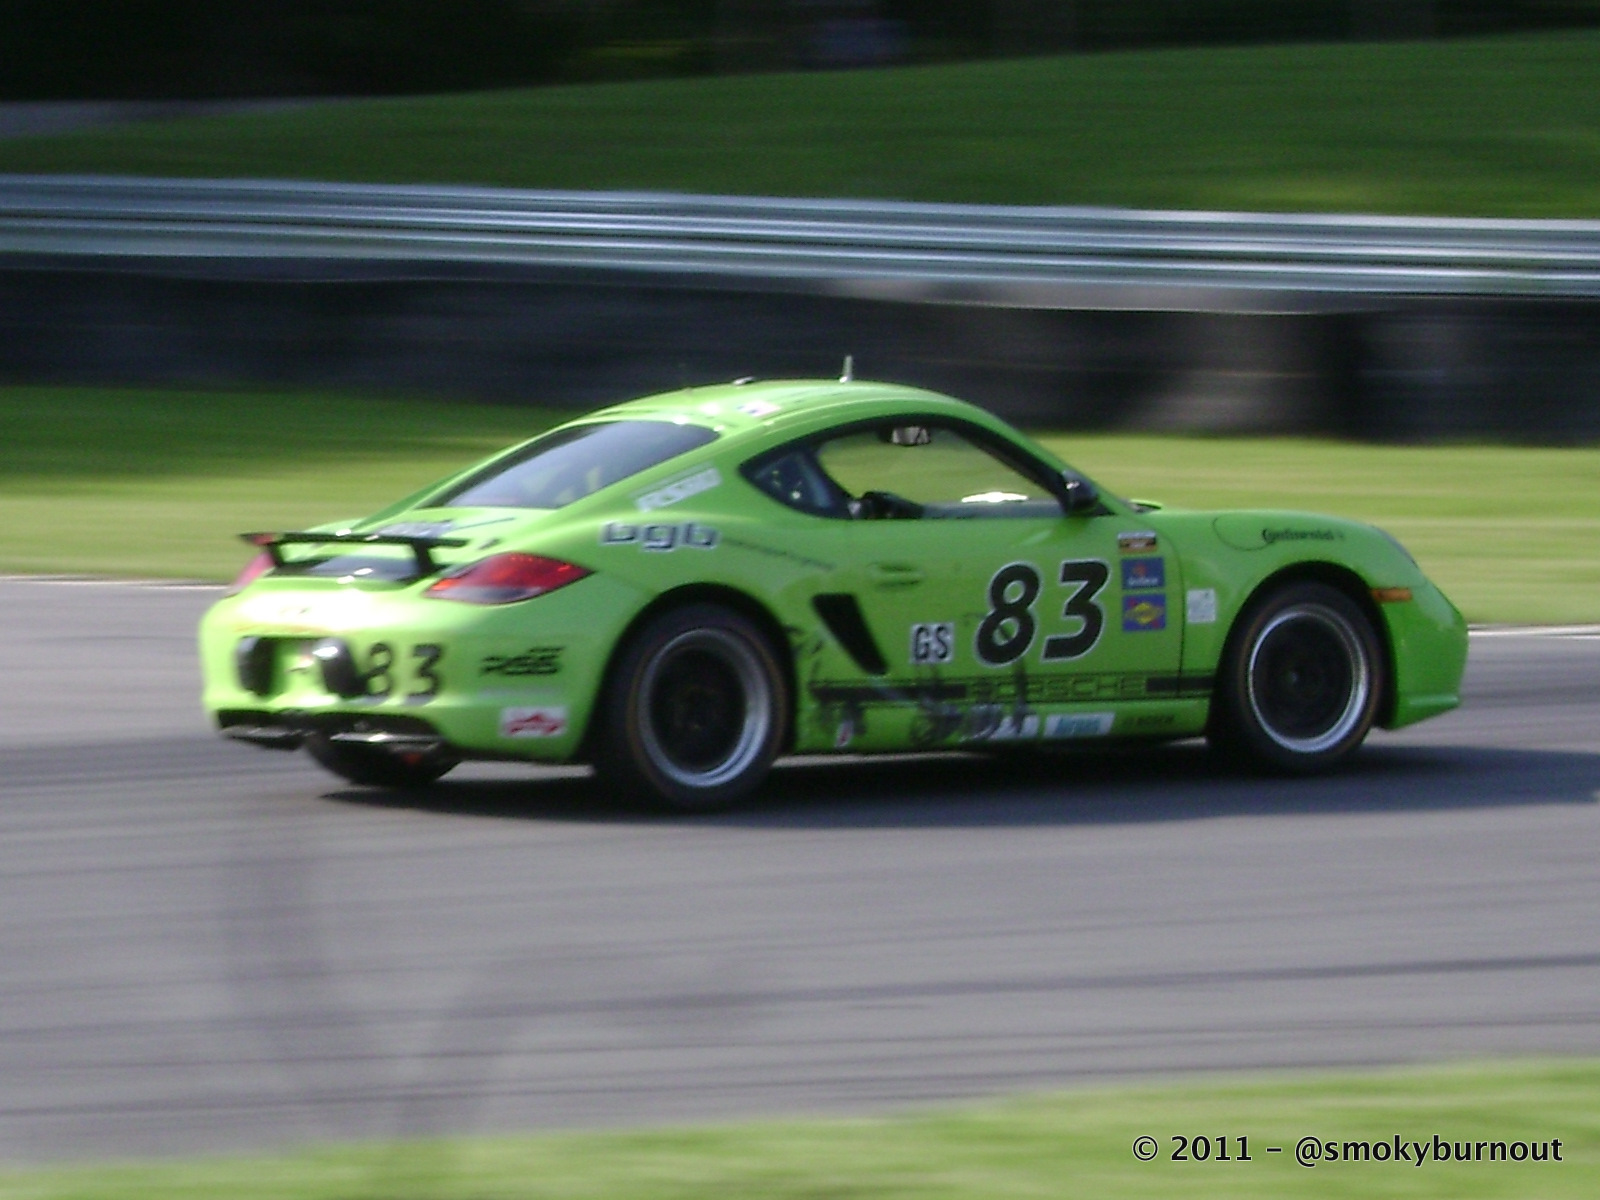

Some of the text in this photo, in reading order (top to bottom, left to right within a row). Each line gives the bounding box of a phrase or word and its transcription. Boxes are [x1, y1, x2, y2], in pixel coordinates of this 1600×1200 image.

[600, 521, 718, 552] bgb
[977, 558, 1110, 668] 83
[913, 624, 950, 661] GS
[363, 642, 443, 705] 83
